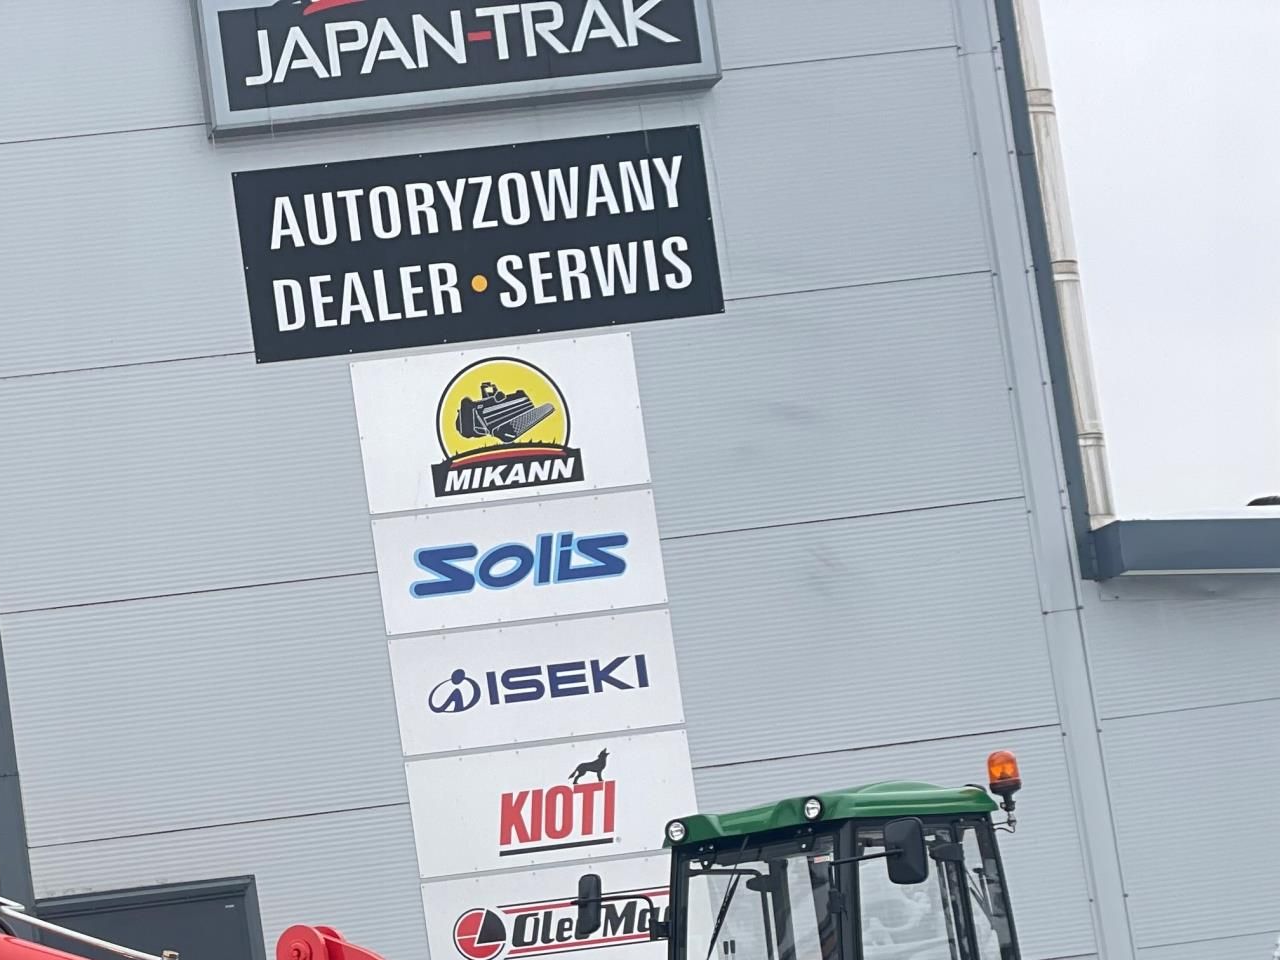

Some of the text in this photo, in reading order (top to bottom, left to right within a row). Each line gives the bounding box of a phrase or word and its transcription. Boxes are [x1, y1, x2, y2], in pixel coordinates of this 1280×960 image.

[245, 0, 681, 87] JAPAN-TRAK
[270, 155, 683, 250] AUTORYZOWANY
[272, 235, 693, 332] DEALER SERWIS
[443, 456, 575, 492] MIKANN
[486, 654, 649, 705] ISEKI
[499, 780, 616, 846] KIOTI
[512, 900, 671, 948] Ole Ma
